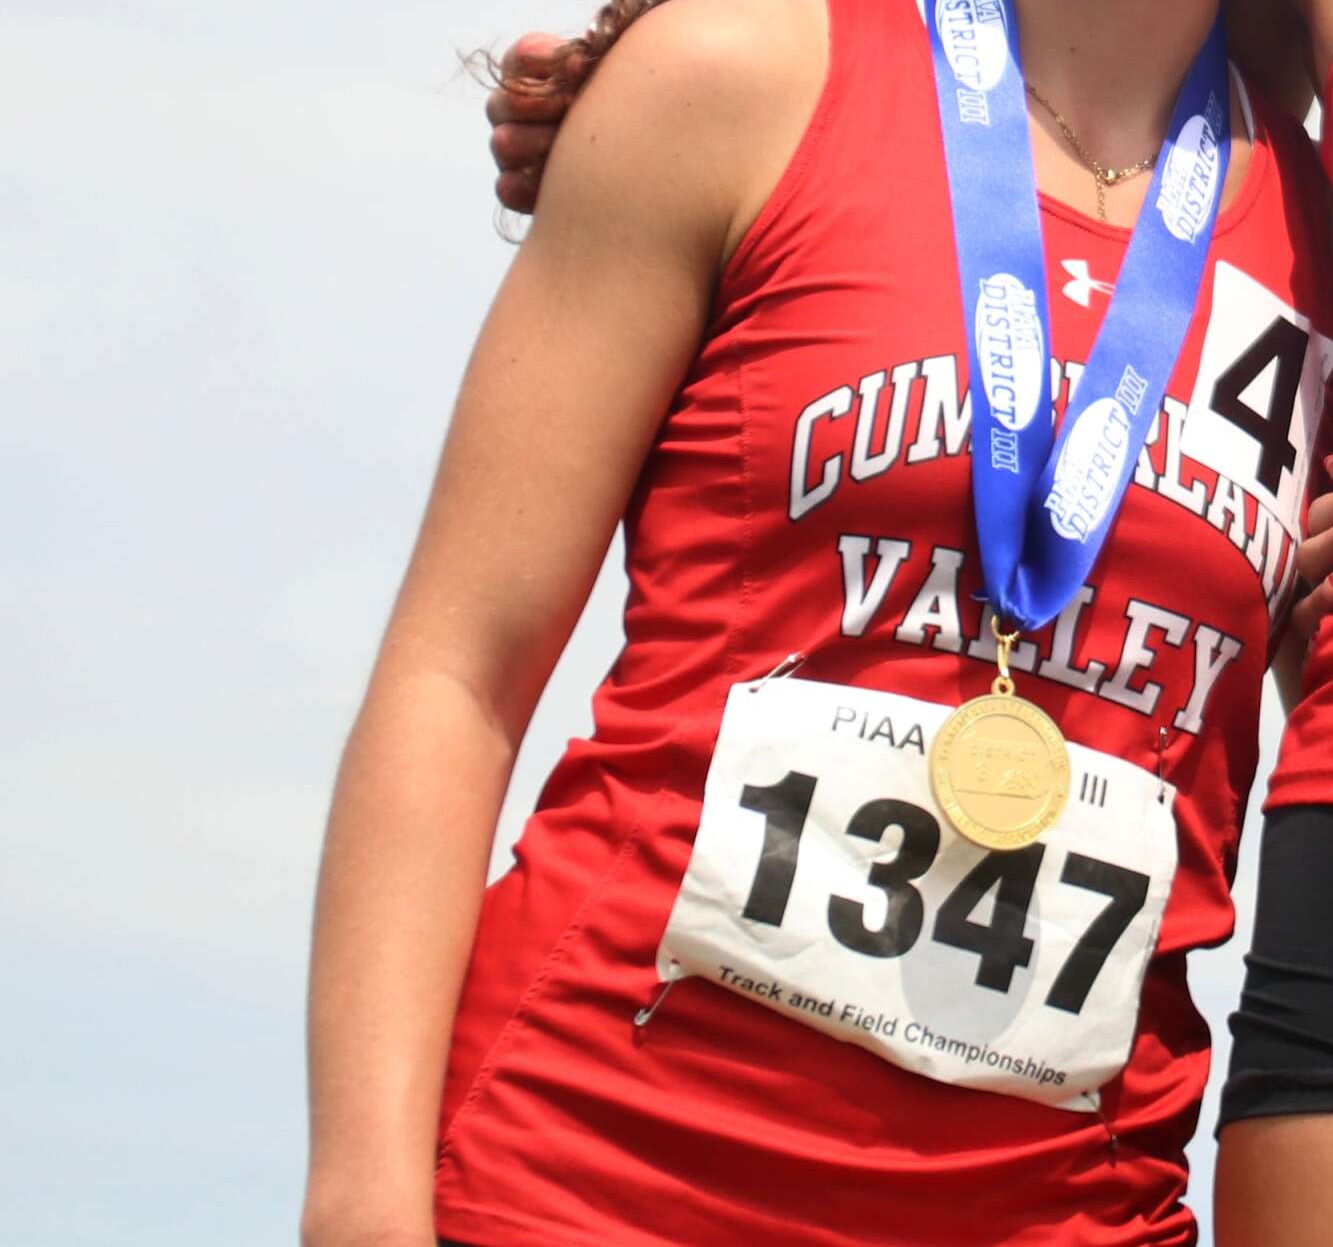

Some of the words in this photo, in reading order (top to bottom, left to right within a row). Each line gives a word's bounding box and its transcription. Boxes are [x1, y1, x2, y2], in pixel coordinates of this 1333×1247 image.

[1174, 128, 1220, 244] DISTRICT
[980, 279, 1018, 424] DISTRICT
[1209, 314, 1310, 498] 4
[1068, 406, 1131, 544] DISTRICT
[831, 704, 926, 756] PIAA
[1080, 771, 1109, 809] III
[738, 769, 1151, 1016] 1347
[718, 964, 782, 1002] Track
[788, 988, 834, 1021] and
[839, 1003, 899, 1037] Field
[903, 1020, 1068, 1087] Championships
